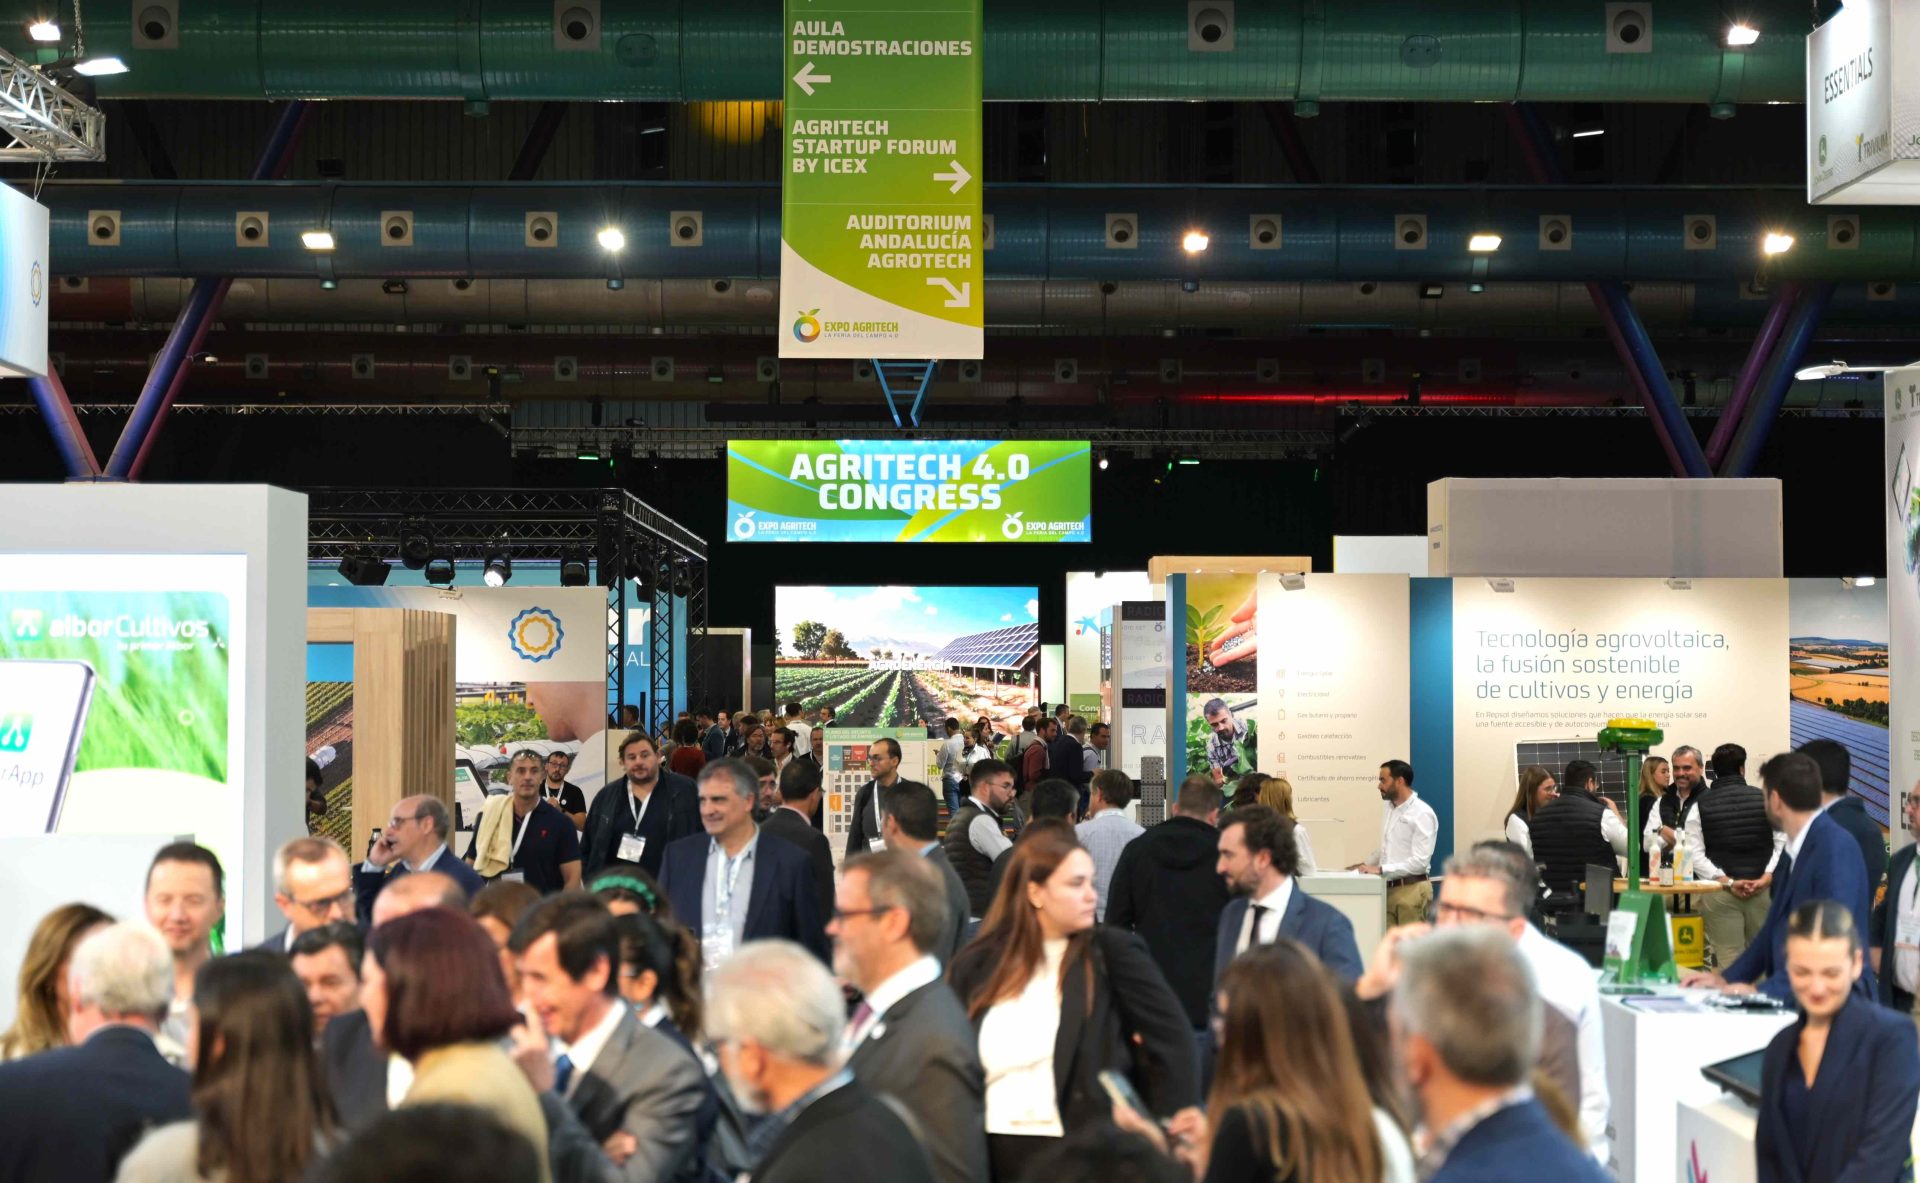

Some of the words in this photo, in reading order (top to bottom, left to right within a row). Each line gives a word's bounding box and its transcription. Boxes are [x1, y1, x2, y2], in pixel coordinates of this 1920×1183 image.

[792, 21, 845, 36] AULA
[792, 40, 972, 56] DEMOSTRACIONES
[1824, 47, 1873, 105] ESSENTIALS
[792, 120, 889, 136] AGRITECH
[792, 139, 882, 155] STARTUP
[887, 139, 957, 155] FORUM
[792, 158, 817, 174] BY
[824, 158, 868, 174] ICEX
[846, 214, 972, 231] AUDITORIUM
[860, 230, 972, 250] ANDALUCÍA
[867, 253, 972, 269] AGROTECH
[824, 322, 850, 332] EXPO
[852, 322, 899, 332] AGRITECH
[789, 453, 962, 481] AGRITECH
[972, 453, 1030, 481] 4.0
[818, 482, 1002, 511] CONGRESS
[758, 521, 779, 531] EXPO
[780, 521, 817, 531] AGRITECH
[1026, 521, 1047, 531] EXPO
[1048, 521, 1085, 531] AGRITECH
[49, 614, 209, 638] alborCultivos
[1475, 628, 1588, 653] Tecnología
[1595, 629, 1730, 653] agrovoltaica,
[1476, 654, 1495, 673] la
[1501, 654, 1565, 673] fusión
[1572, 654, 1680, 674] sostenible
[1476, 680, 1501, 699] de
[1508, 680, 1591, 699] cultivos
[1597, 684, 1609, 703] y
[1616, 680, 1693, 704] energía
[1486, 711, 1510, 720] Repsol
[1648, 711, 1674, 720] energía
